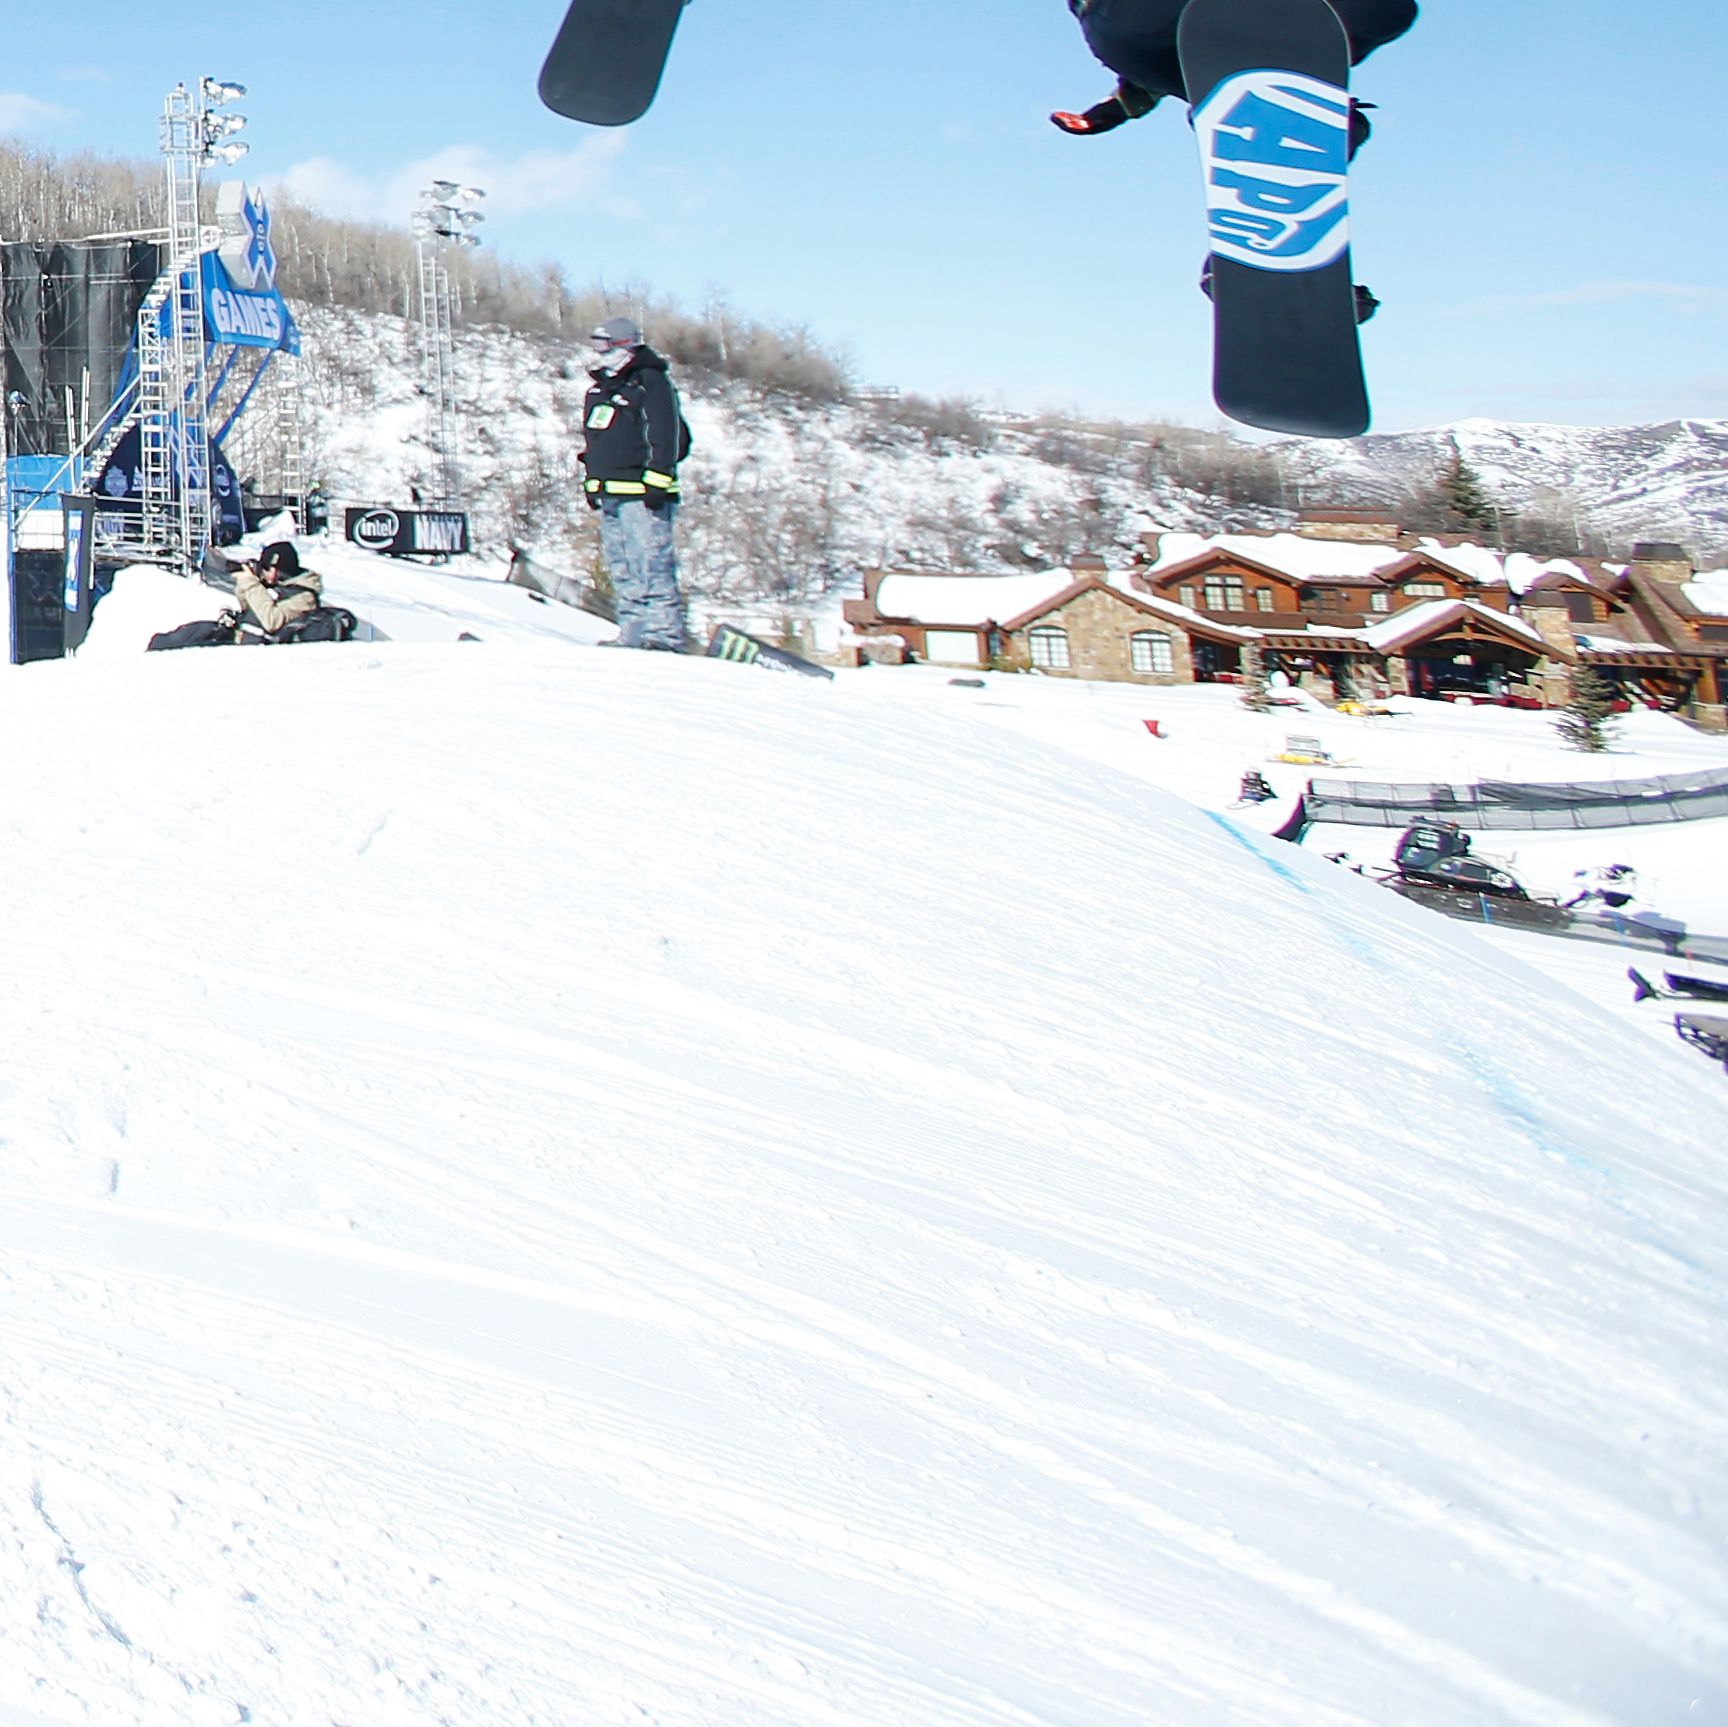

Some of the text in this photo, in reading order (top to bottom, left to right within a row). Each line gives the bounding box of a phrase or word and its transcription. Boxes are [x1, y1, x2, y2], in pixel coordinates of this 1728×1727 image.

[211, 287, 281, 341] GAMES
[360, 516, 393, 537] intel
[414, 515, 463, 550] NAVY
